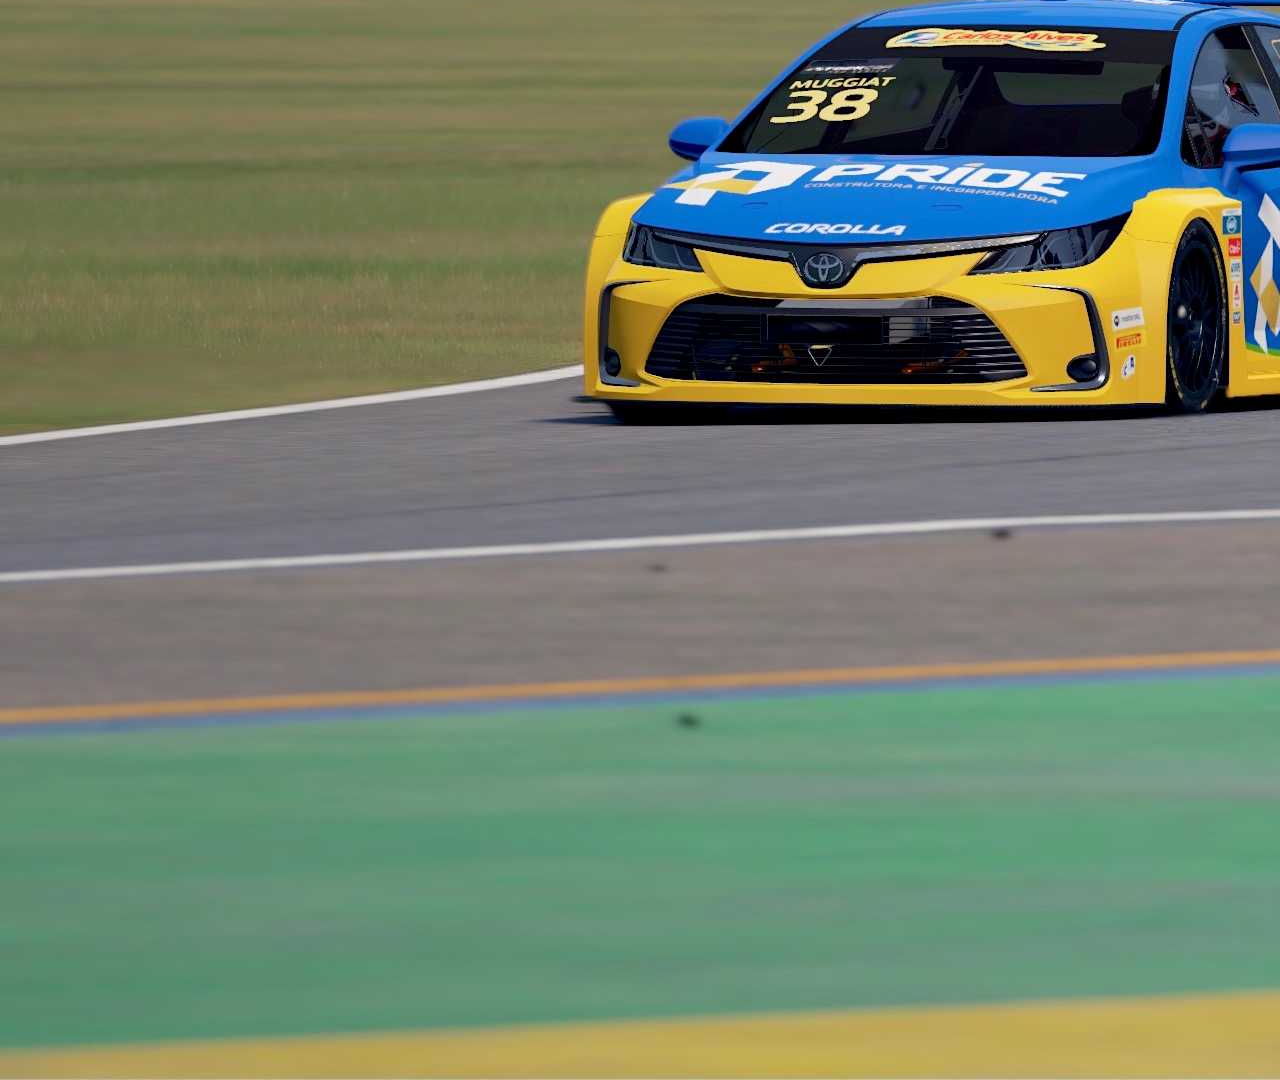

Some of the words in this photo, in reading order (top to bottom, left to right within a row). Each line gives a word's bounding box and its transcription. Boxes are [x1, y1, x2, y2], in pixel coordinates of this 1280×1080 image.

[788, 76, 897, 90] MUGGIAT
[769, 87, 879, 124] 38
[812, 163, 1088, 198] PRIDE
[764, 222, 907, 236] COROLLA
